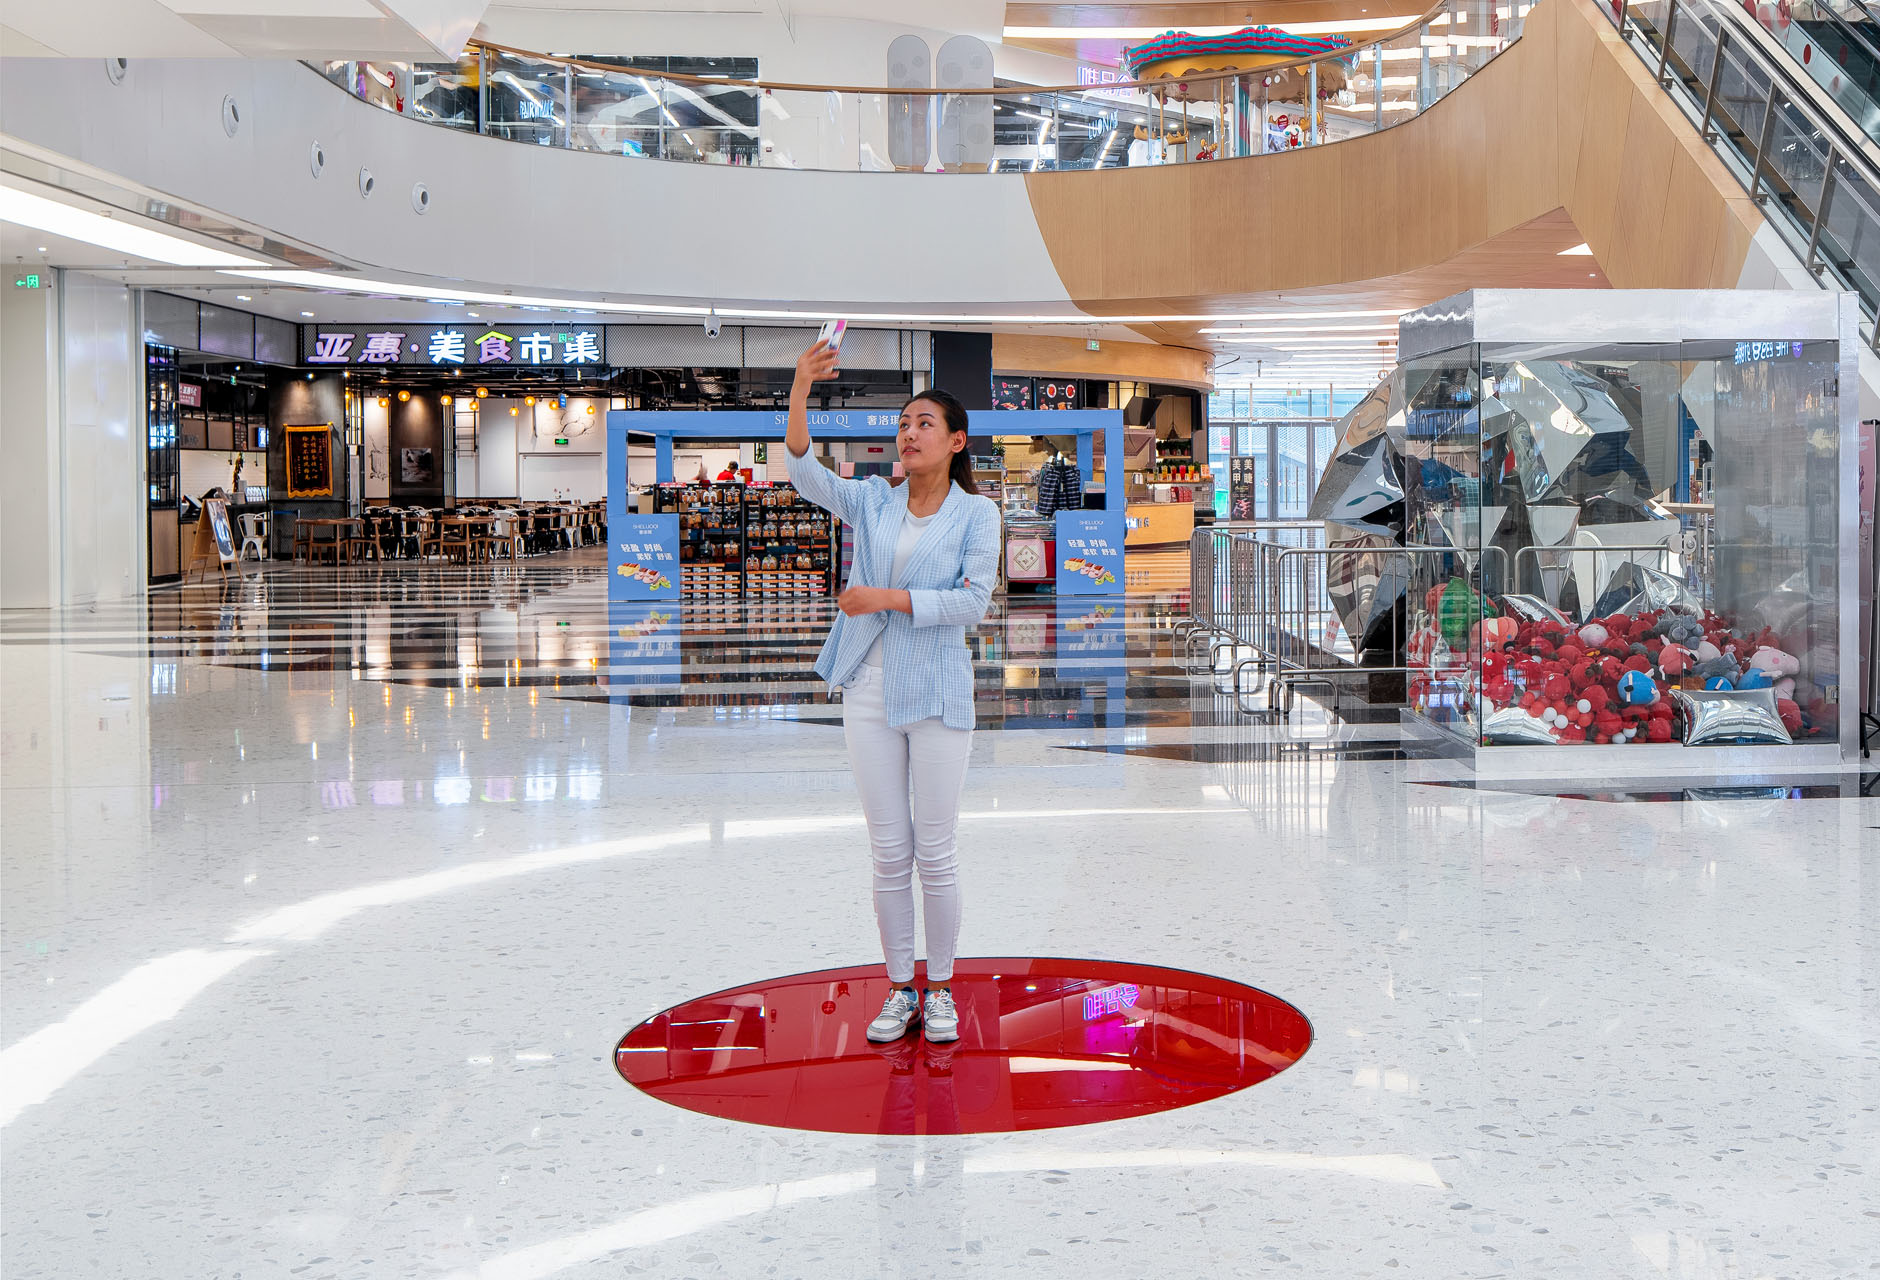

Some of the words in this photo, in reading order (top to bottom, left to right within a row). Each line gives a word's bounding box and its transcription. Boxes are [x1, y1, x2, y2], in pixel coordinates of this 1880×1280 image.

[835, 414, 852, 428] QI
[866, 414, 900, 426] 奢洛琪
[643, 543, 663, 552] 时尚
[1089, 539, 1108, 548] 时尚
